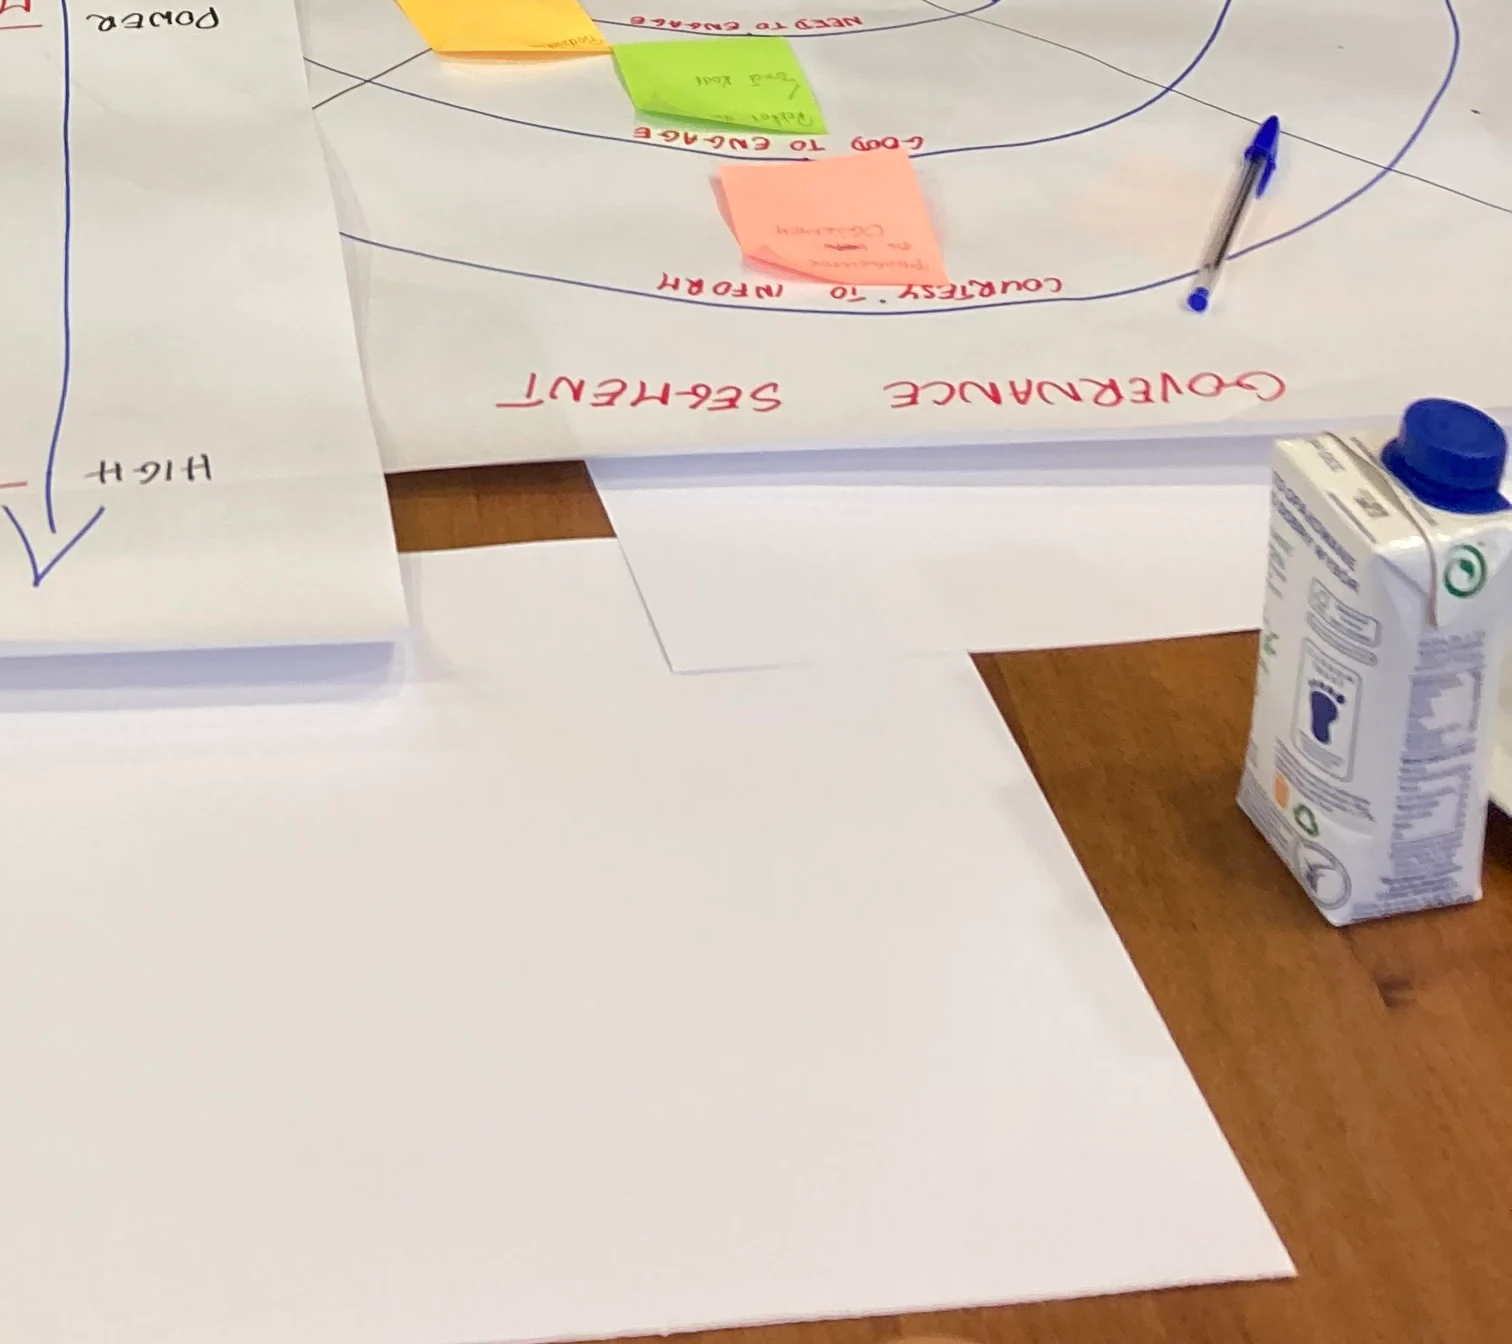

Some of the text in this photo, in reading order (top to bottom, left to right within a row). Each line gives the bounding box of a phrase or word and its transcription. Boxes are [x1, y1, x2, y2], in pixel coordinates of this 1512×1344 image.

[84, 5, 221, 34] POWER
[630, 15, 864, 31] NEED TO ENGAGE
[633, 126, 925, 153] GOOD TO ENGAGE
[656, 272, 1064, 302] COURTESY TO INFORM
[496, 369, 1288, 414] GOVERNANCE SEGMENT
[82, 452, 214, 486] HIGH
